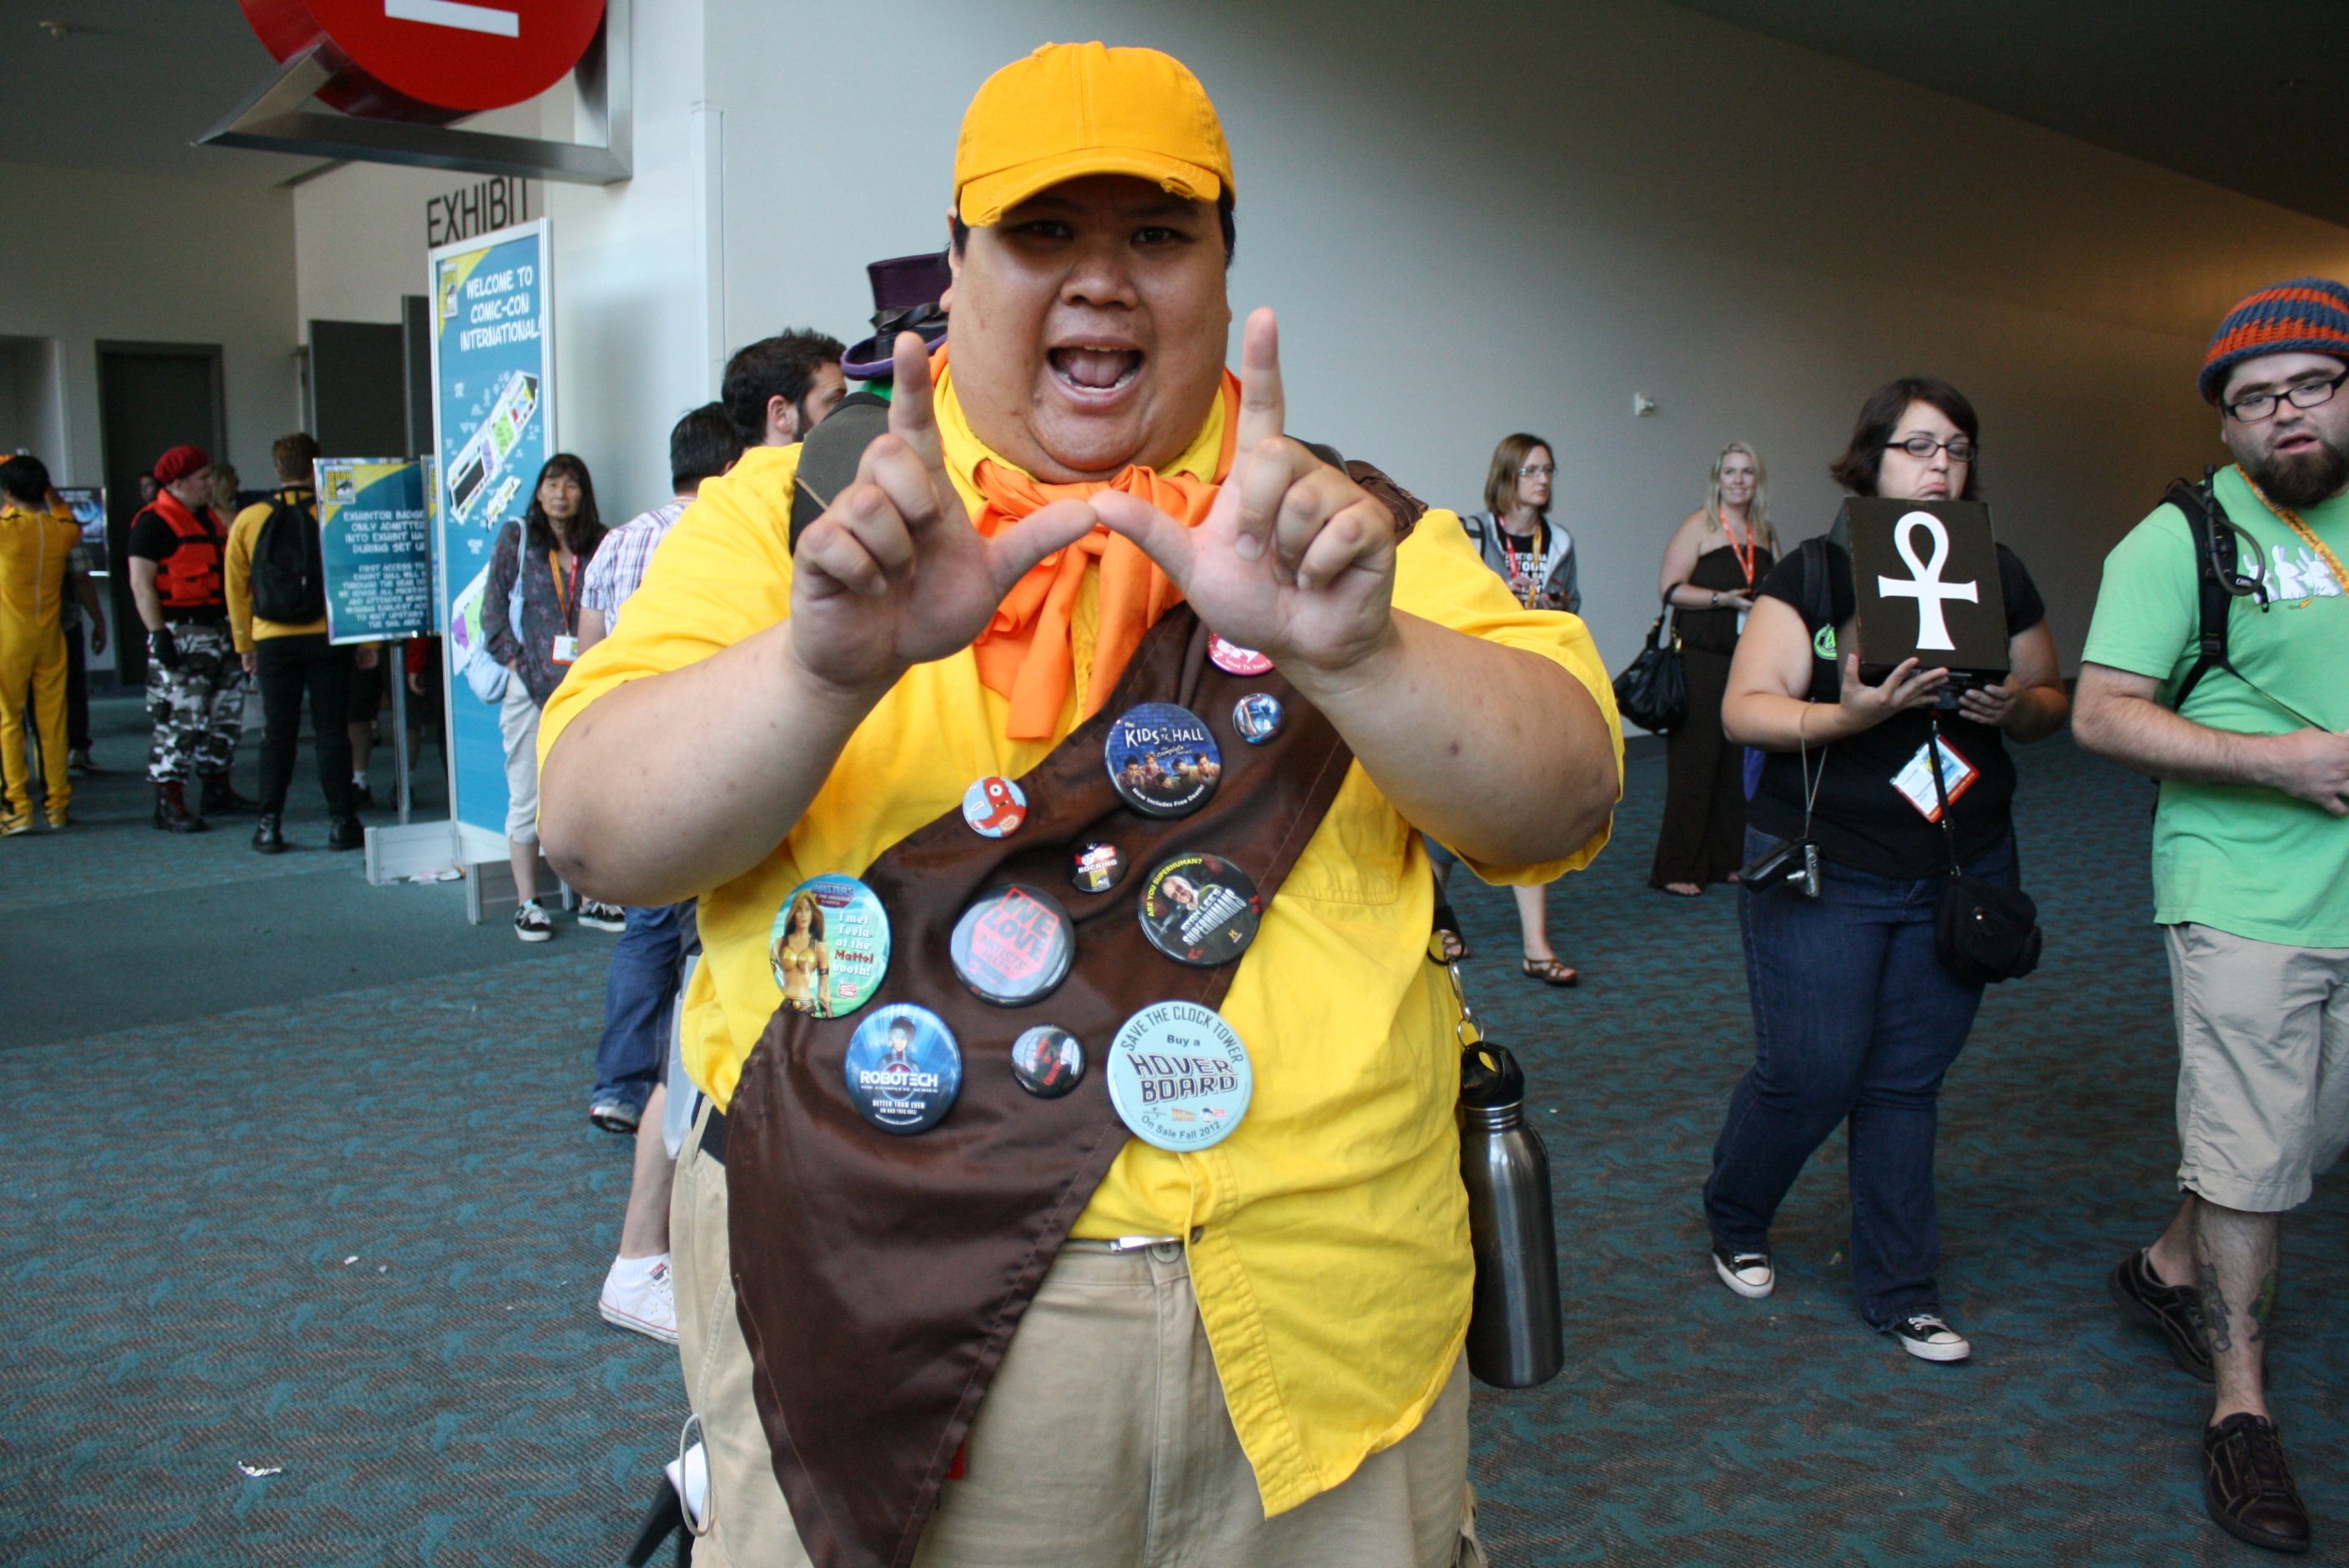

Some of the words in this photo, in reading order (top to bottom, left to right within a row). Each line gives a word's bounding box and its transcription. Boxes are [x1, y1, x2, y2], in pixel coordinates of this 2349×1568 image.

[427, 176, 526, 248] EXHIBIT
[466, 273, 515, 301] WELCOME
[517, 264, 534, 288] TO
[470, 293, 530, 324] COMIC-CON
[460, 314, 543, 351] INTERNATIONAL!
[343, 510, 392, 521] EXHIBITOR
[395, 510, 424, 520] BADGE
[351, 522, 377, 532] ONLY
[380, 520, 425, 530] ADMITTED
[345, 533, 369, 543] INTO
[372, 531, 407, 542] EXHIBIT
[352, 543, 389, 554] DURING
[392, 541, 411, 552] SET
[1125, 728, 1160, 748] KIDS
[1172, 727, 1204, 742] HALL
[1132, 787, 1146, 801] Now
[1146, 797, 1174, 808] Includes
[1174, 799, 1188, 807] Free
[1187, 784, 1205, 802] Death!
[1078, 859, 1118, 874] ROCKING
[1153, 857, 1203, 886] SUPERHUMAN?
[1148, 884, 1157, 901] YOU
[839, 911, 844, 922] I
[846, 913, 869, 925] met
[1001, 897, 1055, 939] WE
[1146, 902, 1155, 917] ARE
[1180, 907, 1203, 932] STAN
[1181, 887, 1247, 946] SUPERHUMANS
[836, 938, 848, 948] at
[851, 938, 871, 951] the
[983, 910, 1043, 962] LOVE
[835, 949, 873, 964] Mattel
[833, 962, 871, 977] booth!
[1120, 1019, 1149, 1052] SAVE
[1145, 1007, 1170, 1028] THE
[1173, 1006, 1214, 1029] CLOCK
[1213, 1021, 1245, 1064] TOWER
[1167, 1034, 1190, 1048] Buy
[1193, 1038, 1201, 1047] a
[1124, 1053, 1238, 1078] HOVER
[860, 1070, 938, 1088] ROBOTECH
[1140, 1075, 1238, 1106] BOARD
[1141, 1115, 1154, 1128] On
[1156, 1124, 1177, 1139] Sale
[1180, 1130, 1197, 1140] Fall
[1199, 1120, 1221, 1138] 2012
